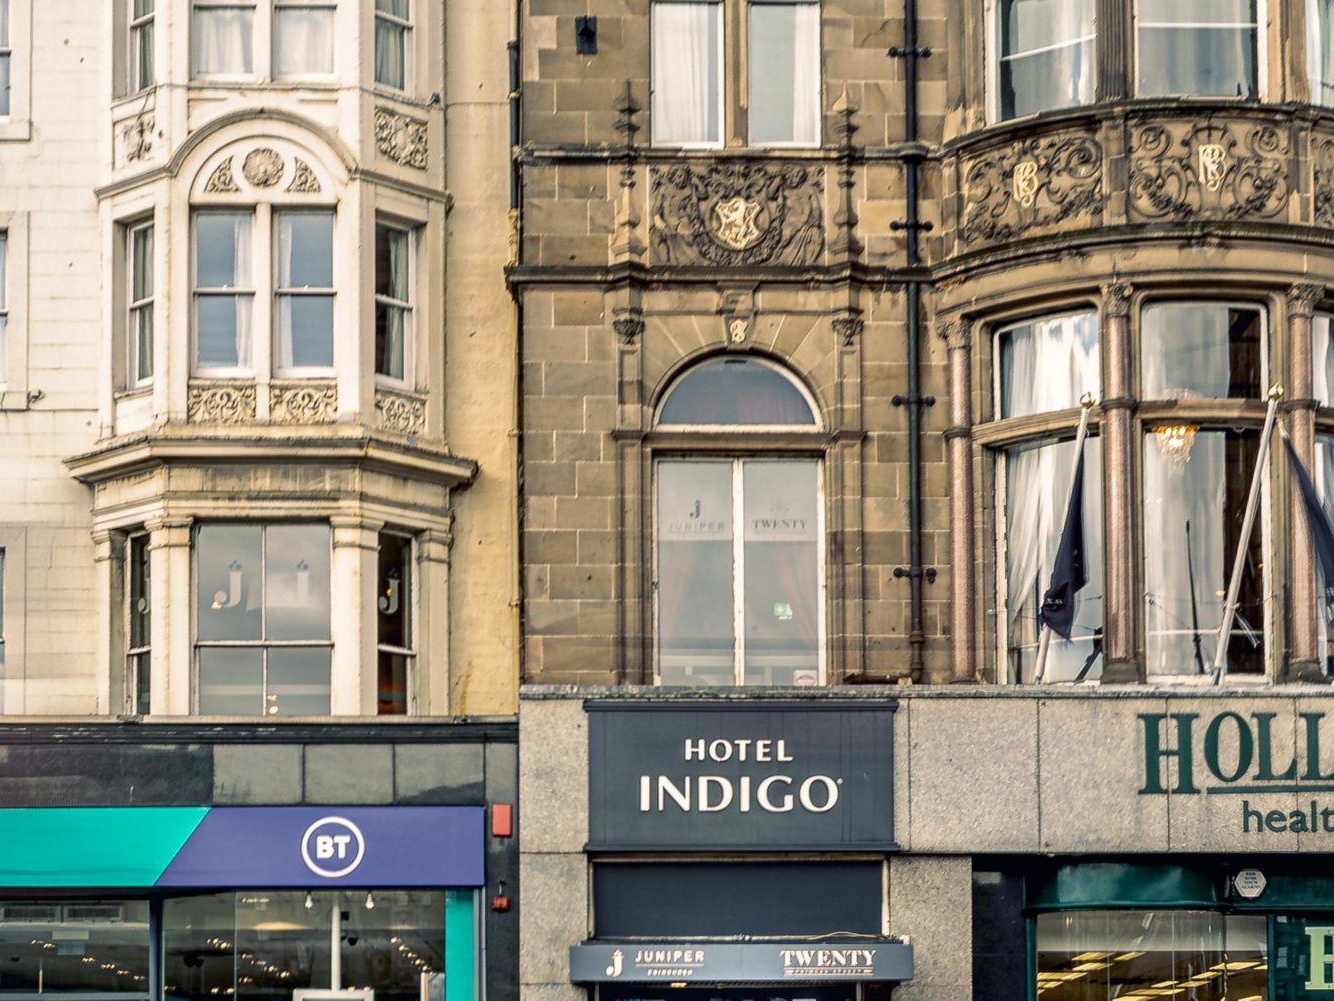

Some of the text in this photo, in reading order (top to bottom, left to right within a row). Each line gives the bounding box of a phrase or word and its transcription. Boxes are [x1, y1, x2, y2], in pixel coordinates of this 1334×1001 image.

[753, 519, 808, 530] TWENTY
[684, 738, 794, 762] HOTEL
[640, 774, 840, 812] INDIGO
[316, 835, 351, 859] BT
[635, 950, 705, 963] JUNIPER
[779, 950, 876, 967] TWENTY
